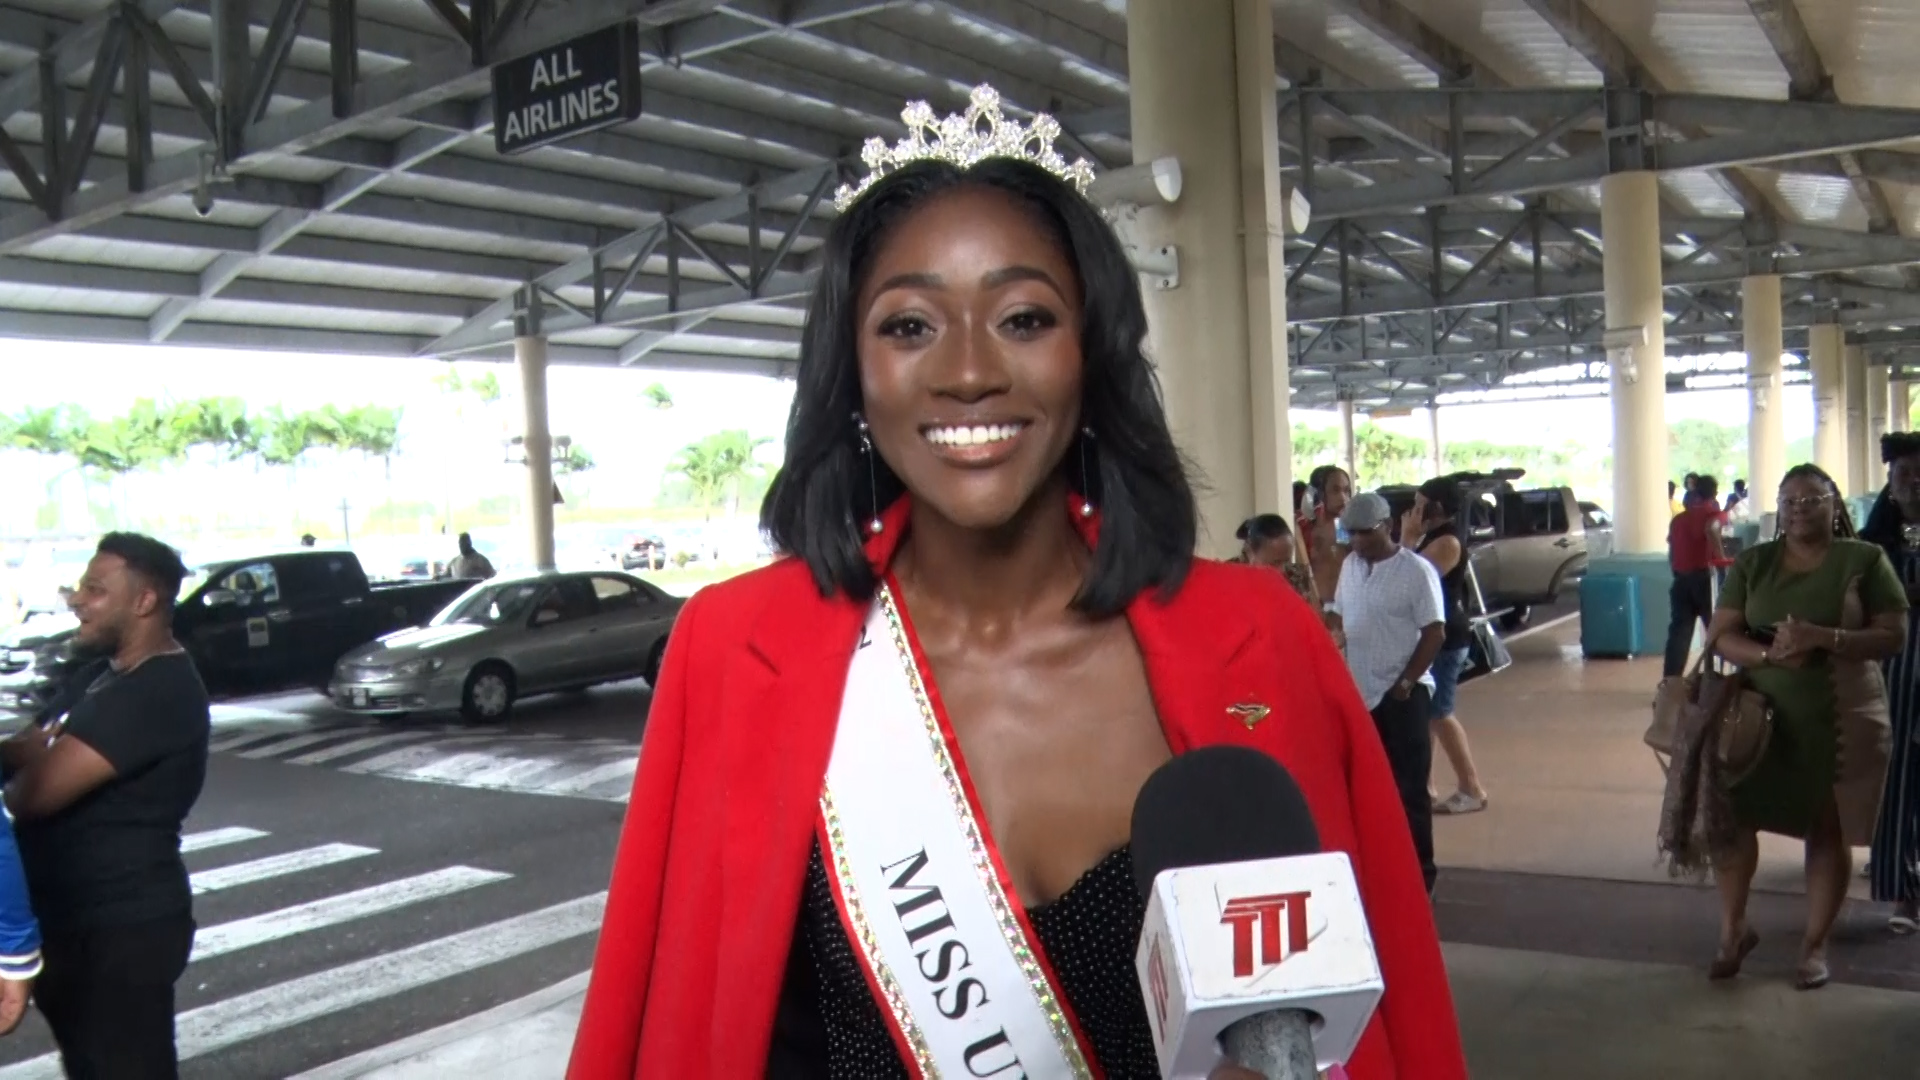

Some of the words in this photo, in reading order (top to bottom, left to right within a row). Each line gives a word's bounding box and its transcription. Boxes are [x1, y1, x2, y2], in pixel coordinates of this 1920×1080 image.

[530, 47, 582, 92] ALL
[503, 79, 620, 143] AIRLINES
[880, 844, 992, 1020] MISS
[963, 1024, 1029, 1080] U
